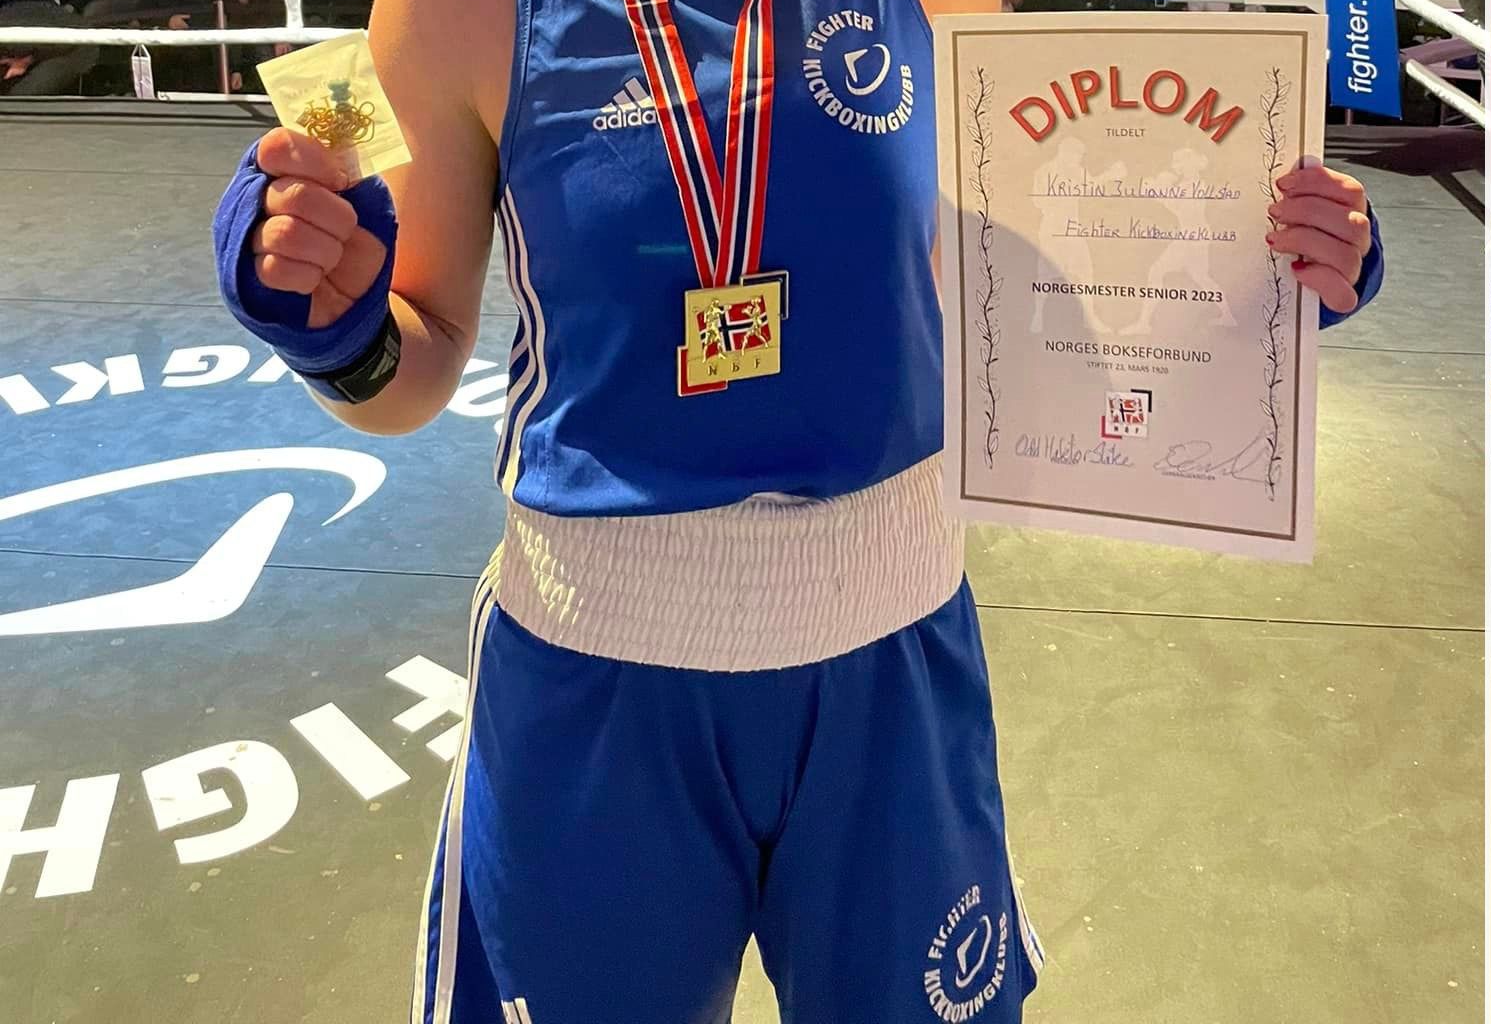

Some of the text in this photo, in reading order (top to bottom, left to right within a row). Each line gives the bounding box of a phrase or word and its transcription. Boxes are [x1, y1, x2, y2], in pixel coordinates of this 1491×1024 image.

[805, 9, 874, 52] FIGHTER
[1008, 66, 1245, 144] DIPLOM
[593, 108, 657, 131] adida
[1105, 128, 1146, 138] TILDELT
[1031, 282, 1223, 303] NORGESMESTER SENIOR 2023
[1045, 340, 1212, 363] NORGES BOKSEFORBUND
